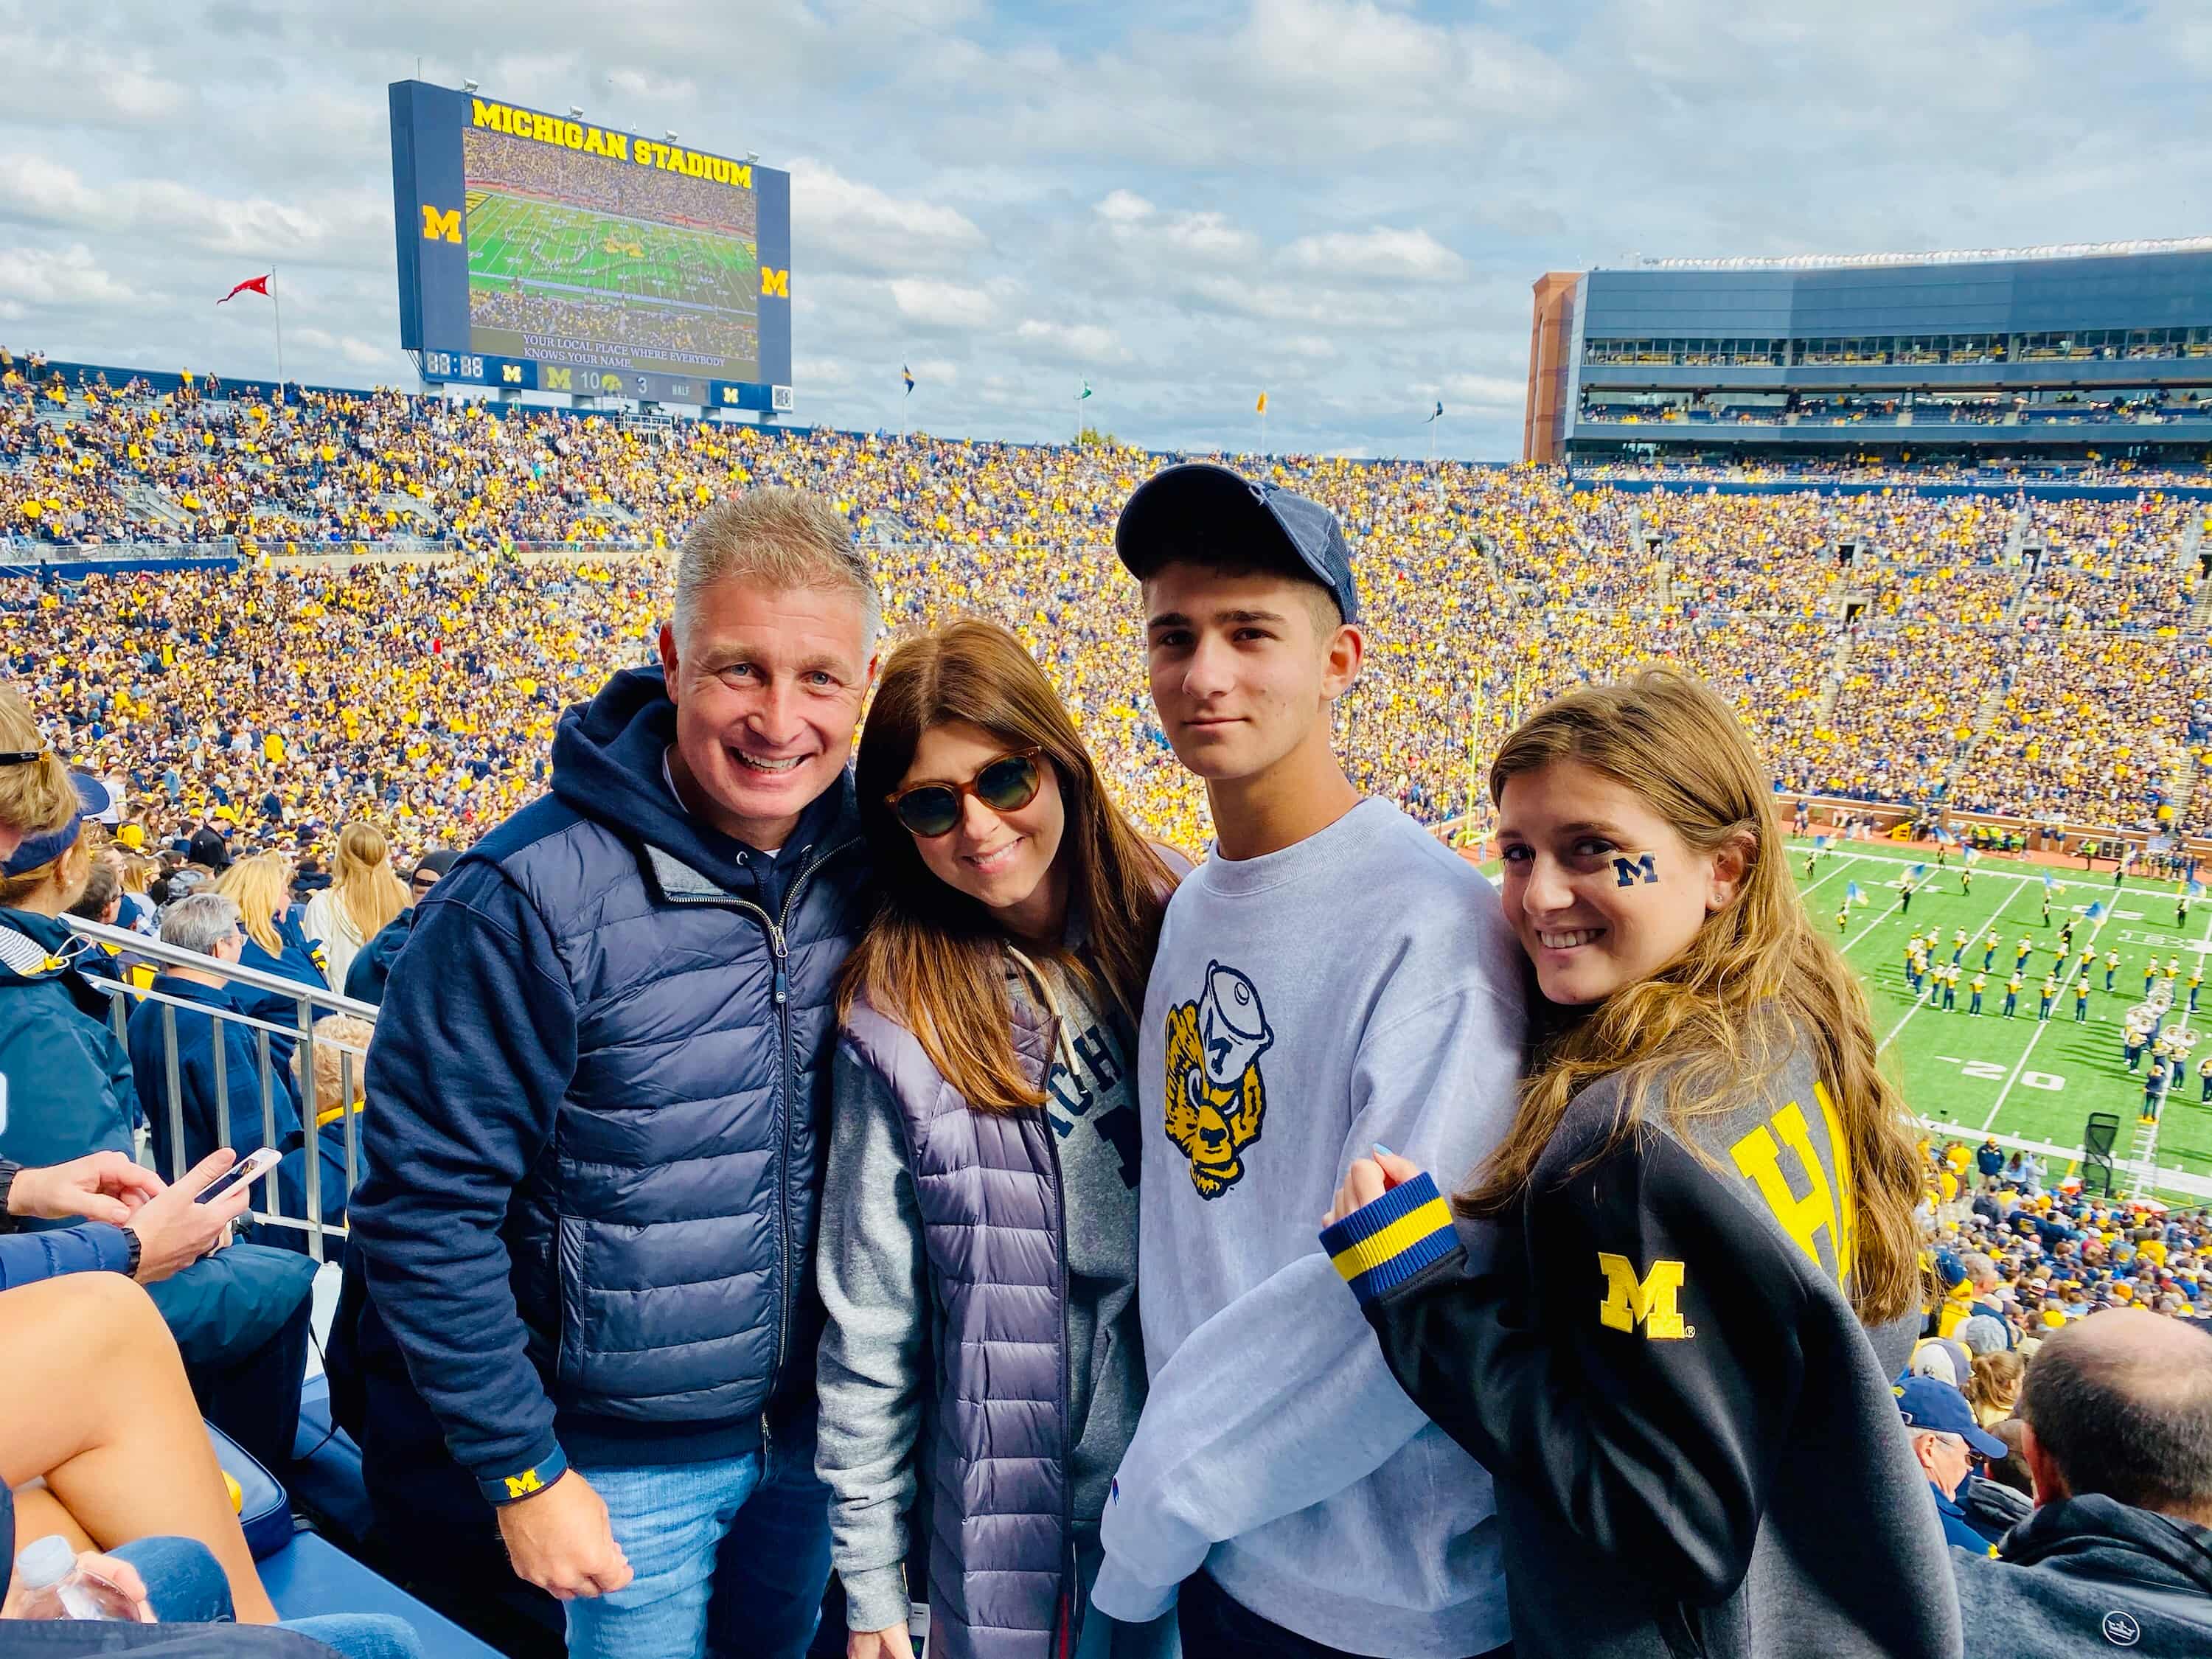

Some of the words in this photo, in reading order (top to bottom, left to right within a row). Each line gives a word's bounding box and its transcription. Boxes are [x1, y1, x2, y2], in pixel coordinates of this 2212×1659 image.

[471, 99, 627, 160] MICHIGAN
[633, 139, 752, 189] STADIUM
[422, 204, 462, 244] M
[762, 267, 788, 298] M
[524, 335, 554, 347] YOUR
[557, 338, 592, 351] LOCAL
[595, 342, 629, 355] PLACE
[630, 347, 668, 361] WHERE
[670, 352, 726, 366] EVERYBODY
[524, 347, 566, 361] KNOWS
[568, 352, 597, 365] YOUR
[502, 364, 521, 383] M
[547, 366, 572, 390] M
[580, 372, 600, 390] 10
[636, 377, 648, 394] 3
[672, 383, 690, 396] HALF
[723, 386, 739, 404] M
[1612, 853, 1658, 888] M
[1961, 1060, 2067, 1092] 20
[1598, 1251, 1685, 1340] M
[504, 1468, 541, 1499] M
